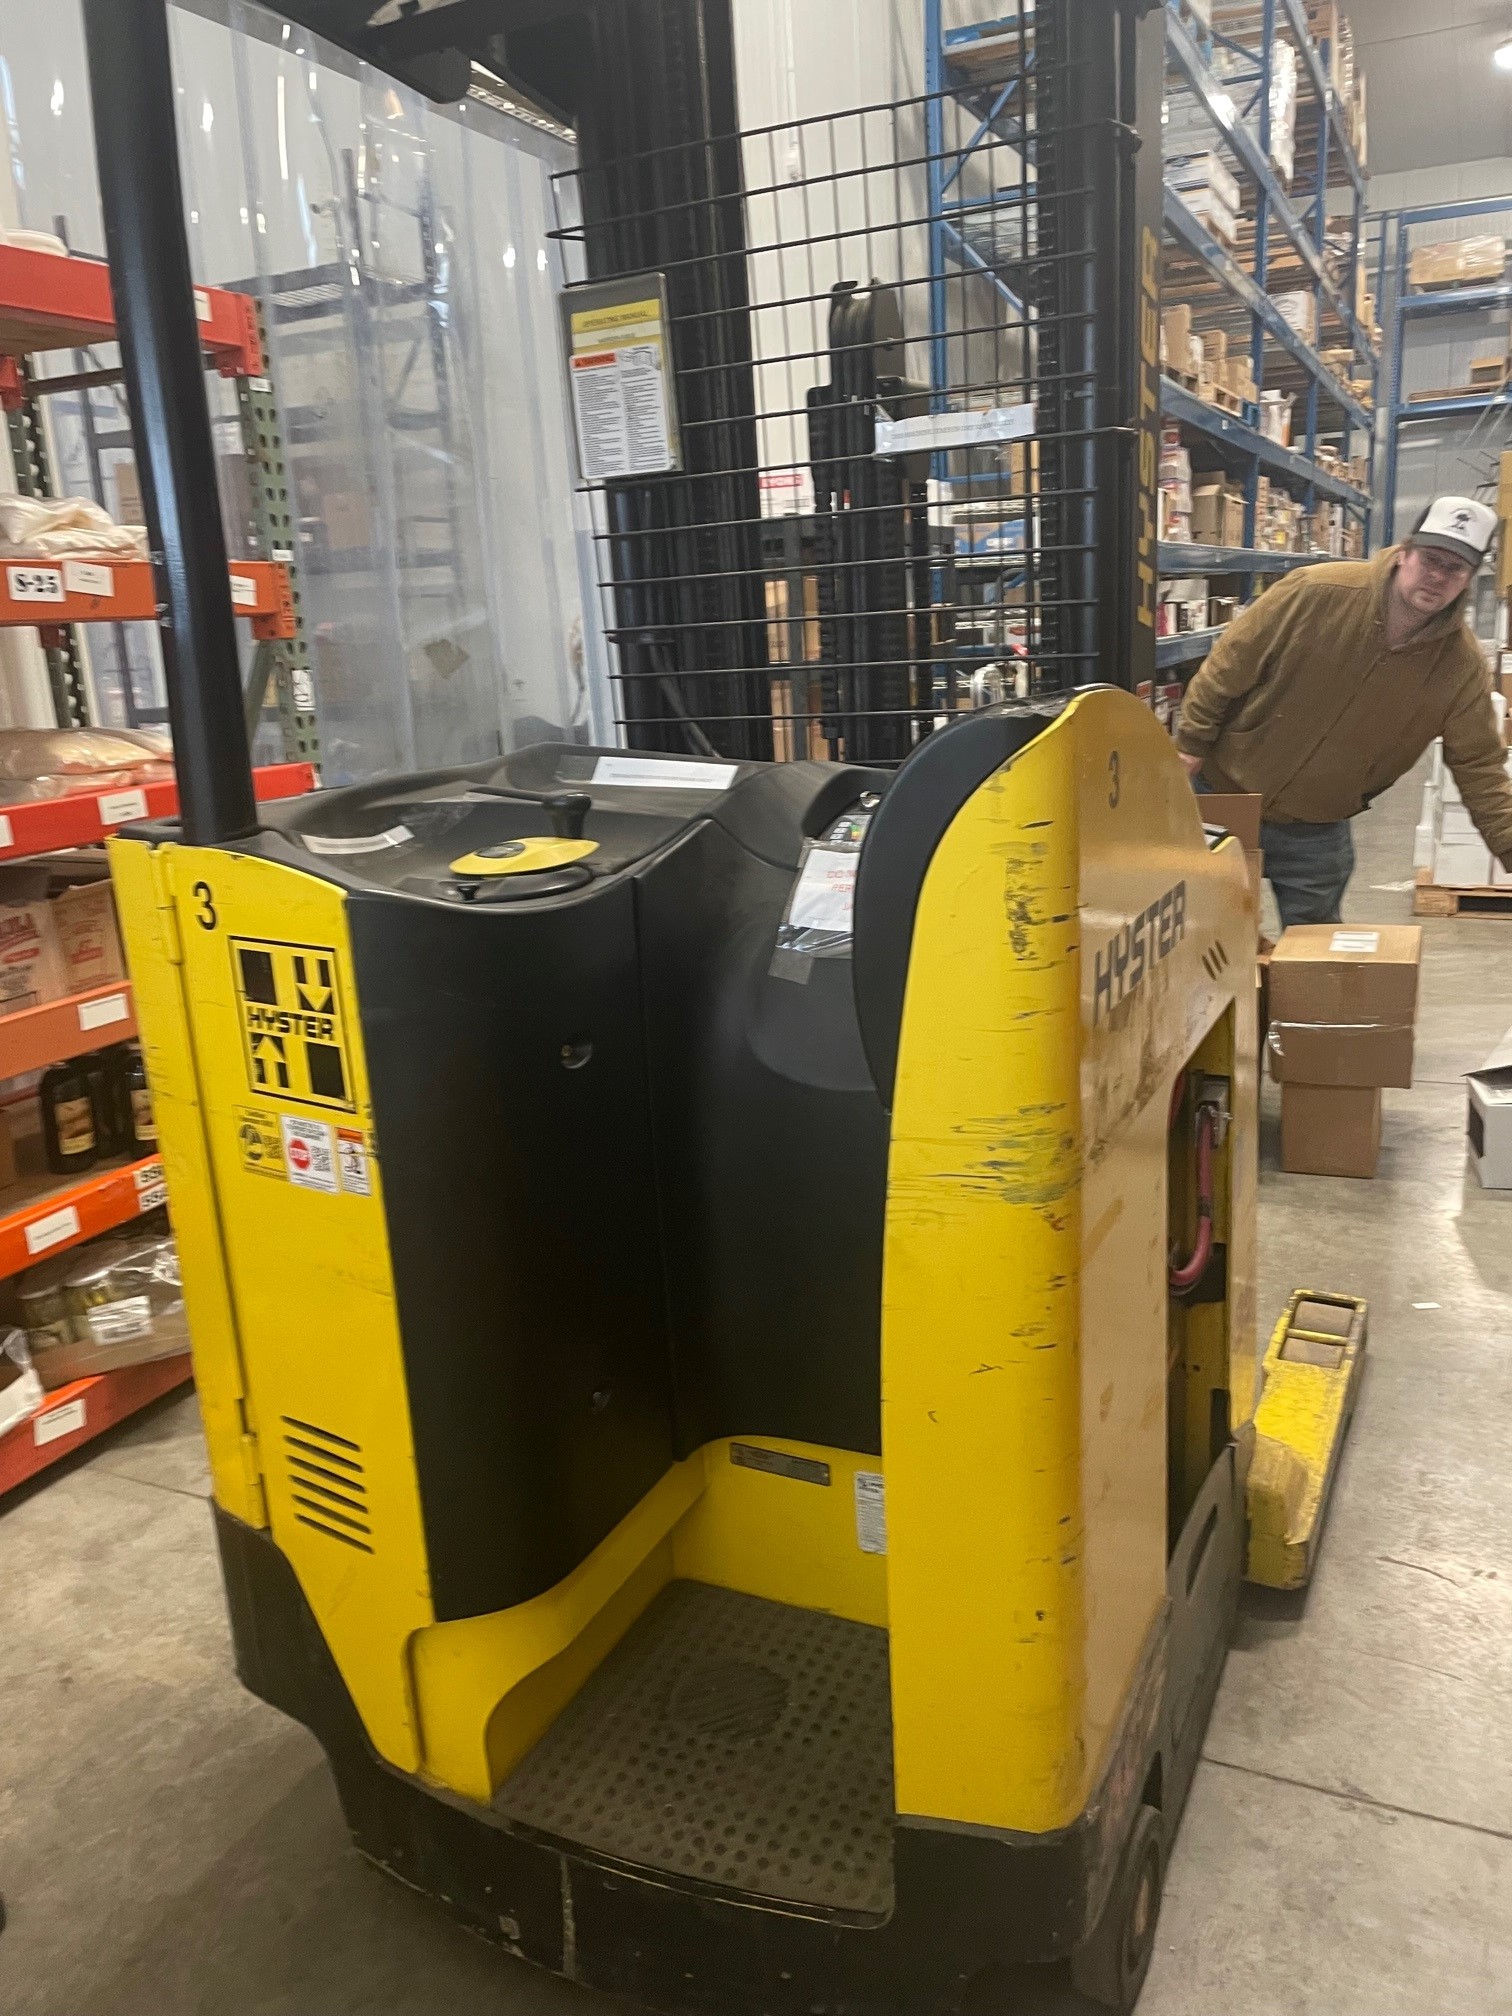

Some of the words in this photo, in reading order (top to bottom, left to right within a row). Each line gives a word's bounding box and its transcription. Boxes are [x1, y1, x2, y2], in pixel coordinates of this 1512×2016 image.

[1138, 225, 1158, 628] HYSTER
[14, 572, 58, 593] S-25
[1107, 750, 1121, 810] 3
[192, 880, 217, 931] 3
[1093, 879, 1186, 1028] HYSTER
[247, 1006, 334, 1040] HYSTER
